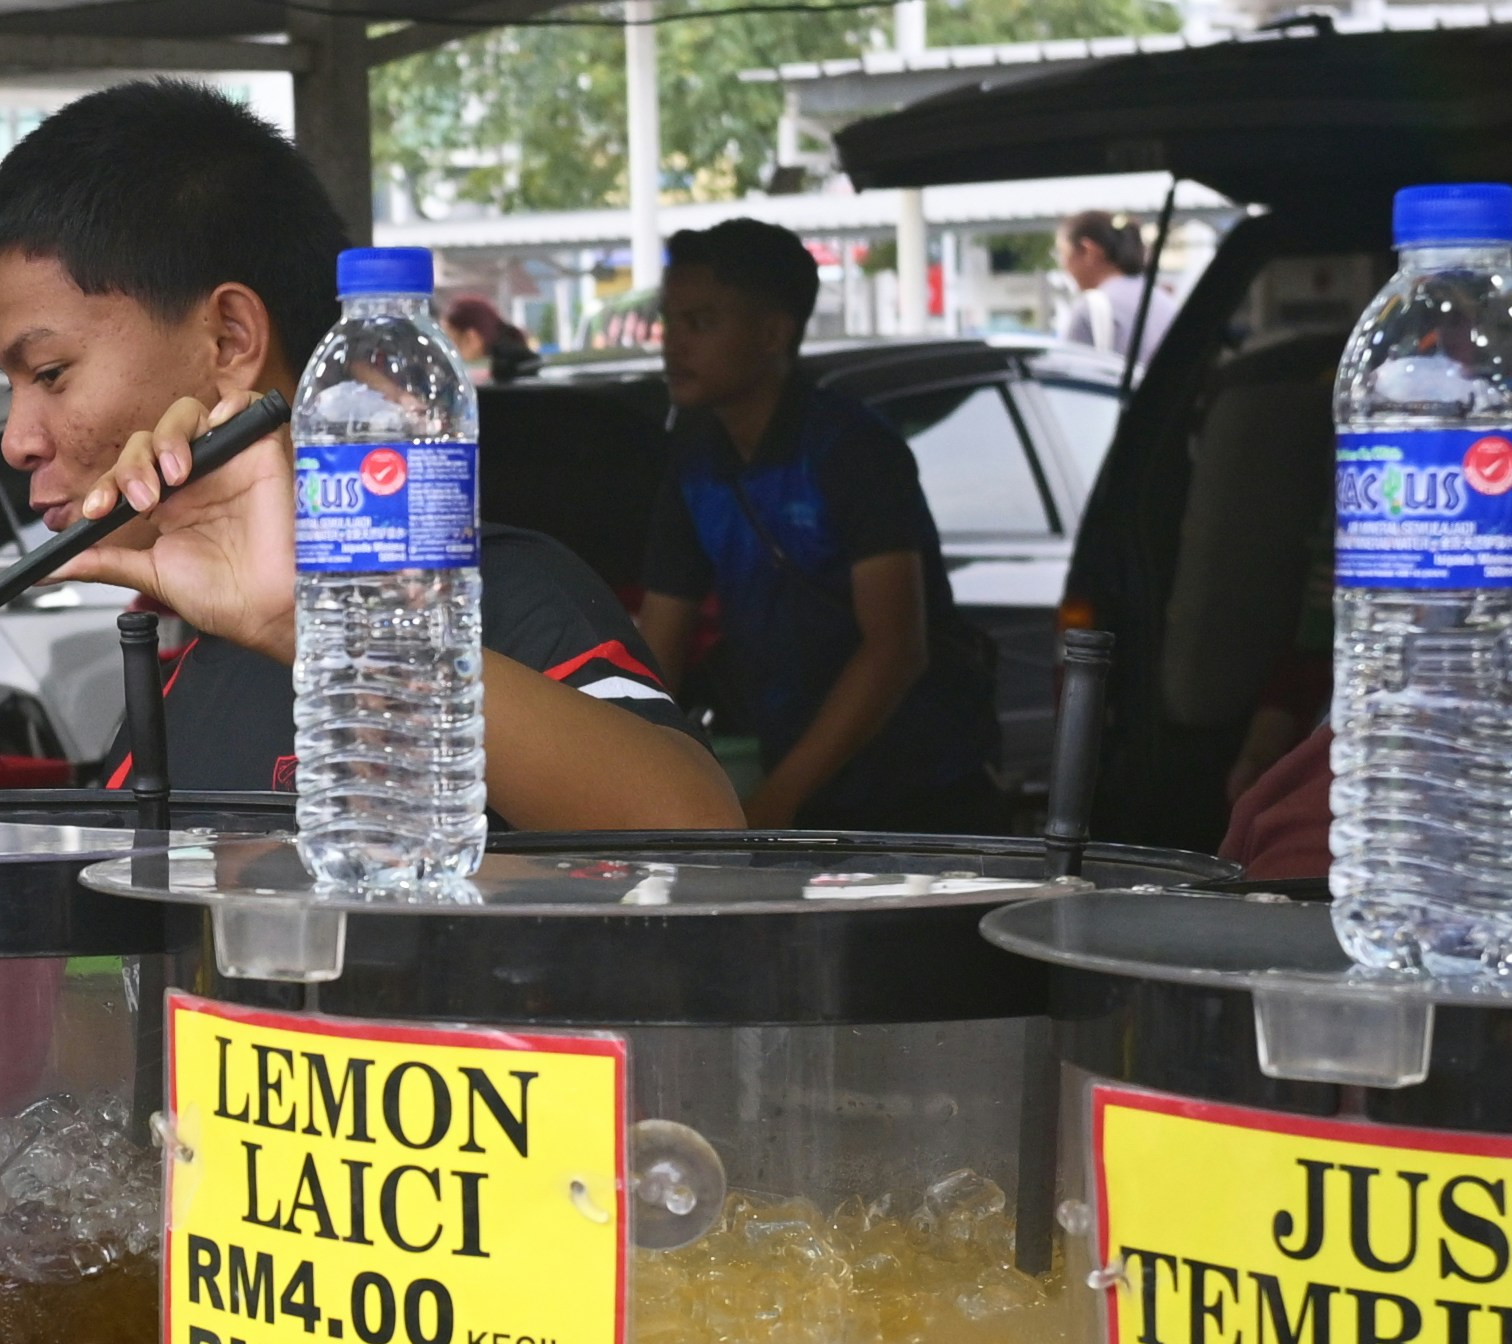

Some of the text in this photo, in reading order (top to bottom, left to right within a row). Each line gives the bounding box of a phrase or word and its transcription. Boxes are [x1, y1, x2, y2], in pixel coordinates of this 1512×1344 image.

[213, 1035, 539, 1159] LEMON
[240, 1140, 491, 1259] LAICI
[1271, 1157, 1511, 1285] JUS
